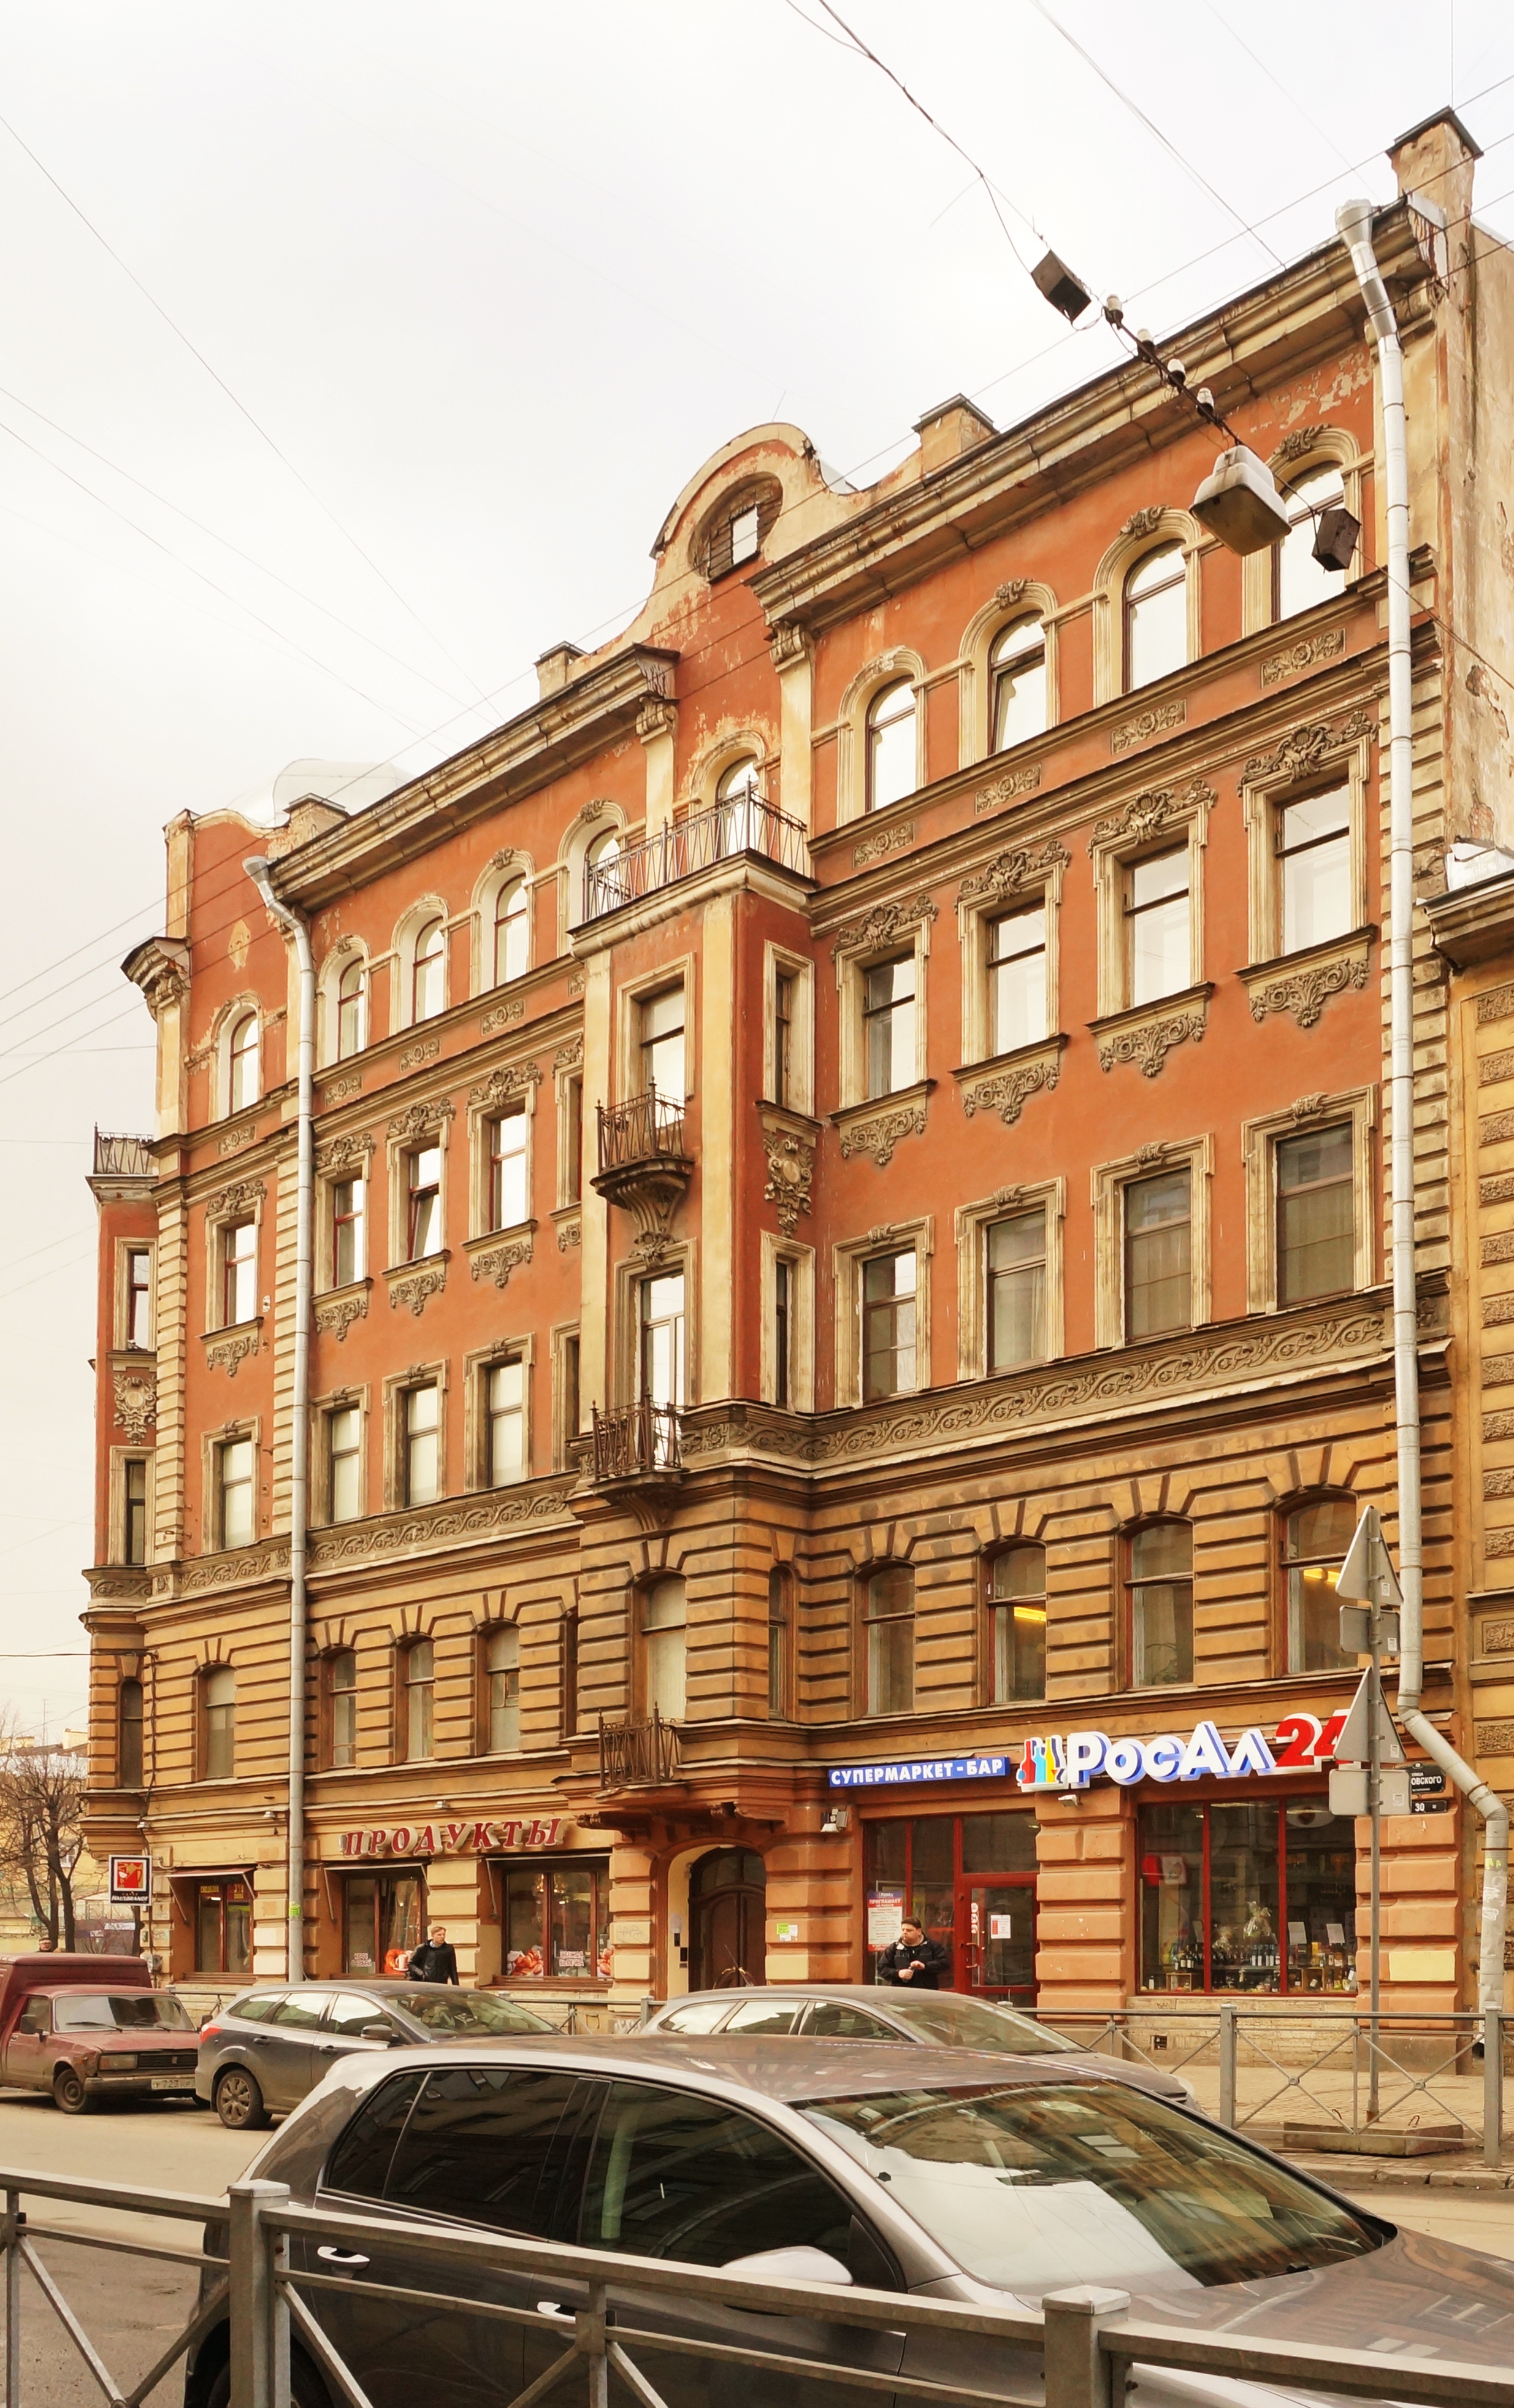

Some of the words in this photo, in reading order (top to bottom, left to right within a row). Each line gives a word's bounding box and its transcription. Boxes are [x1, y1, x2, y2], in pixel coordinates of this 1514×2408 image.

[1067, 1720, 1271, 1784] РосАл
[1411, 1776, 1442, 1785] ОВСКОГО
[1415, 1803, 1424, 1812] 30
[343, 1817, 563, 1857] ПРОДУКТЫ
